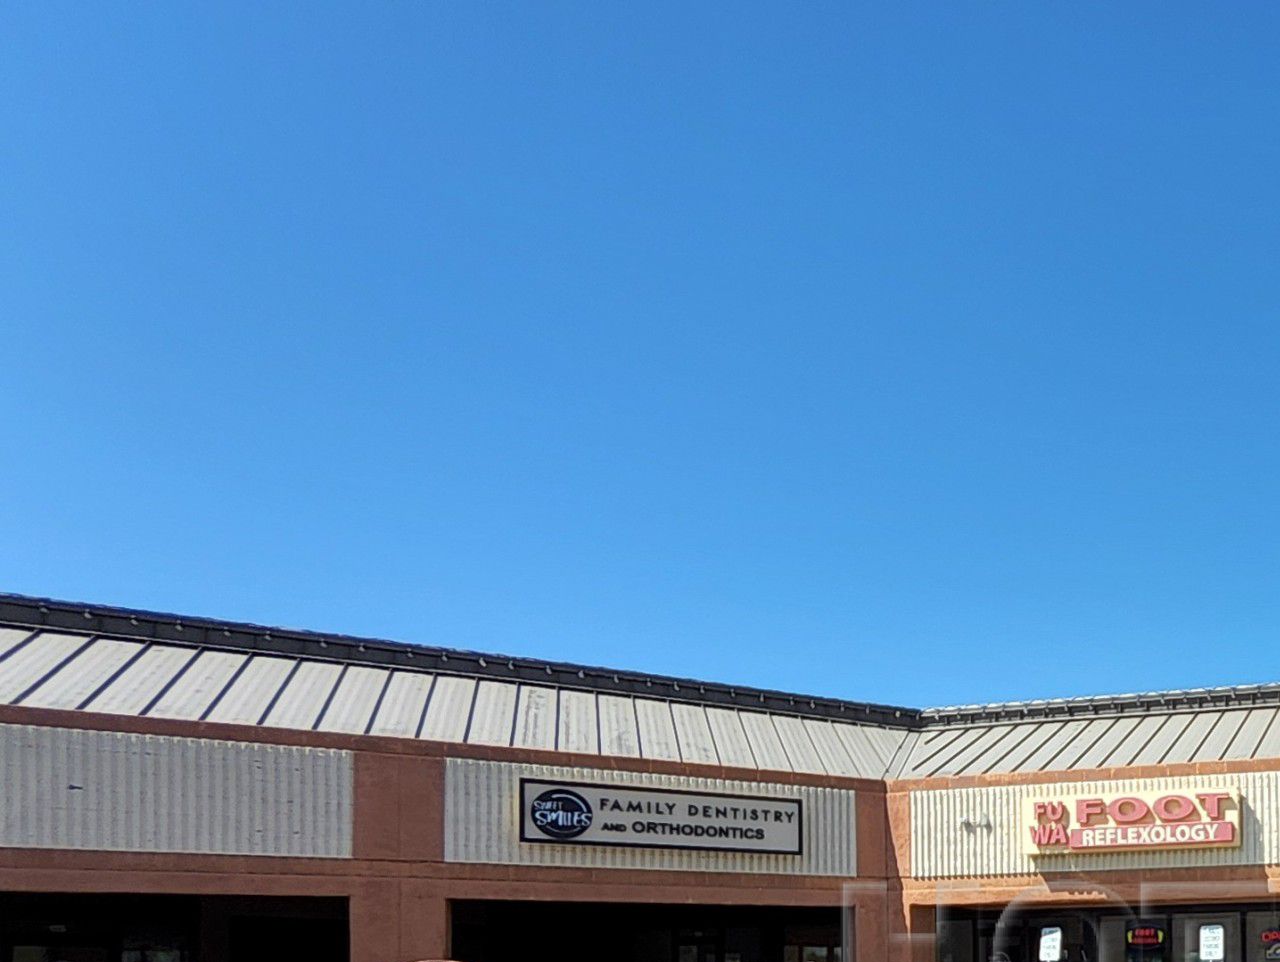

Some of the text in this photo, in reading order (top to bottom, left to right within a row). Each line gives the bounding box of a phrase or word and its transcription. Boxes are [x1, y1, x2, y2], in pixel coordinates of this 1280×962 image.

[599, 798, 796, 824] FAMILY DENTISTRY
[1034, 801, 1064, 821] FU
[1075, 793, 1230, 824] FOOT
[600, 821, 765, 841] AND ORTHODONTICS
[1030, 823, 1068, 845] WA
[1082, 824, 1219, 847] REFLEXOLOGY
